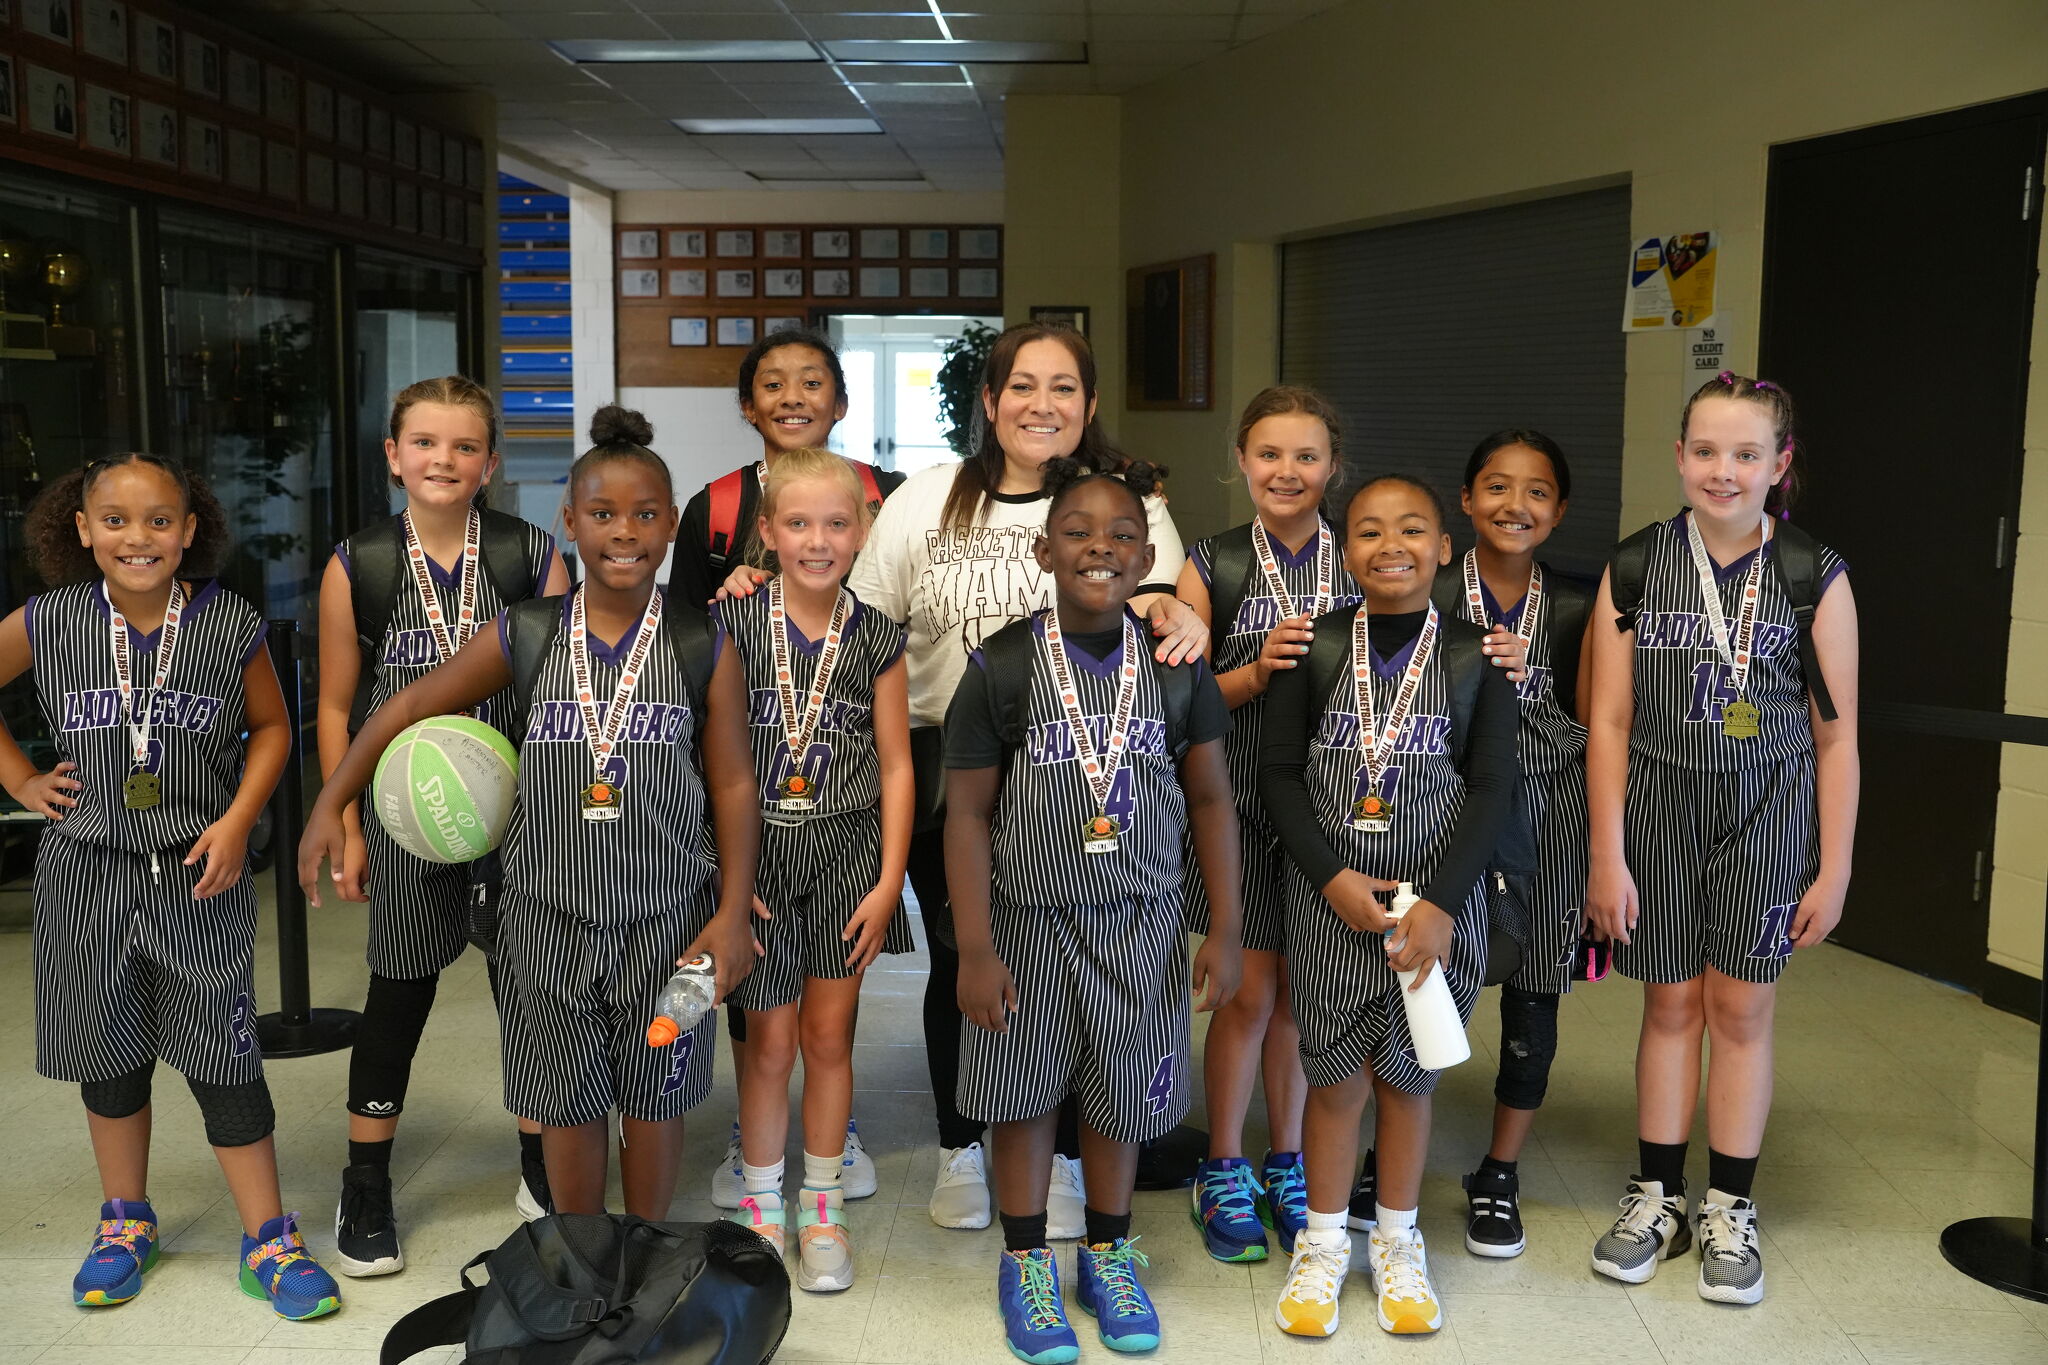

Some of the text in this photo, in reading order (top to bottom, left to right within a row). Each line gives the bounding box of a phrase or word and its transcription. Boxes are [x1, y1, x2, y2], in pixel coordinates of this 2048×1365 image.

[1692, 343, 1724, 353] CREDIT
[1703, 329, 1715, 339] NO
[1695, 357, 1719, 367] CARD
[1253, 525, 1271, 562] BASKETBALL
[1320, 541, 1331, 583] BASKETBALL
[413, 560, 436, 607] BASKETBALL
[463, 559, 477, 608] BASKETBALL
[921, 558, 1054, 645] MAM
[1268, 572, 1294, 618] BASKETBALL
[1521, 592, 1540, 638] BASKETBALL
[1636, 611, 1702, 649] LADY
[1738, 602, 1755, 653] BASKETBALL
[115, 630, 130, 681] BASKETBALL
[158, 624, 176, 673] BASKETBALL
[573, 640, 589, 689] BASKETBALL
[628, 628, 653, 675] BASKETBALL
[772, 620, 788, 668] BASKETBALL
[1050, 642, 1071, 691] BASKETBALL
[1355, 621, 1366, 666] BASKETBALL
[1413, 624, 1436, 669] BASKETBALL
[814, 646, 837, 695] BASKETBALL
[606, 688, 631, 743] BASKETBALL
[780, 683, 797, 734] BASKETBALL
[1115, 680, 1134, 734] BASKETBALL
[1357, 681, 1373, 733] BASKETBALL
[1390, 678, 1416, 730] BASKETBALL
[583, 705, 602, 759] BASKETBALL
[1066, 706, 1092, 760] BASKETBALL
[763, 739, 835, 805] 00
[415, 775, 480, 861] SPALDING
[1104, 766, 1136, 835] 4
[1145, 1051, 1175, 1116] 4
